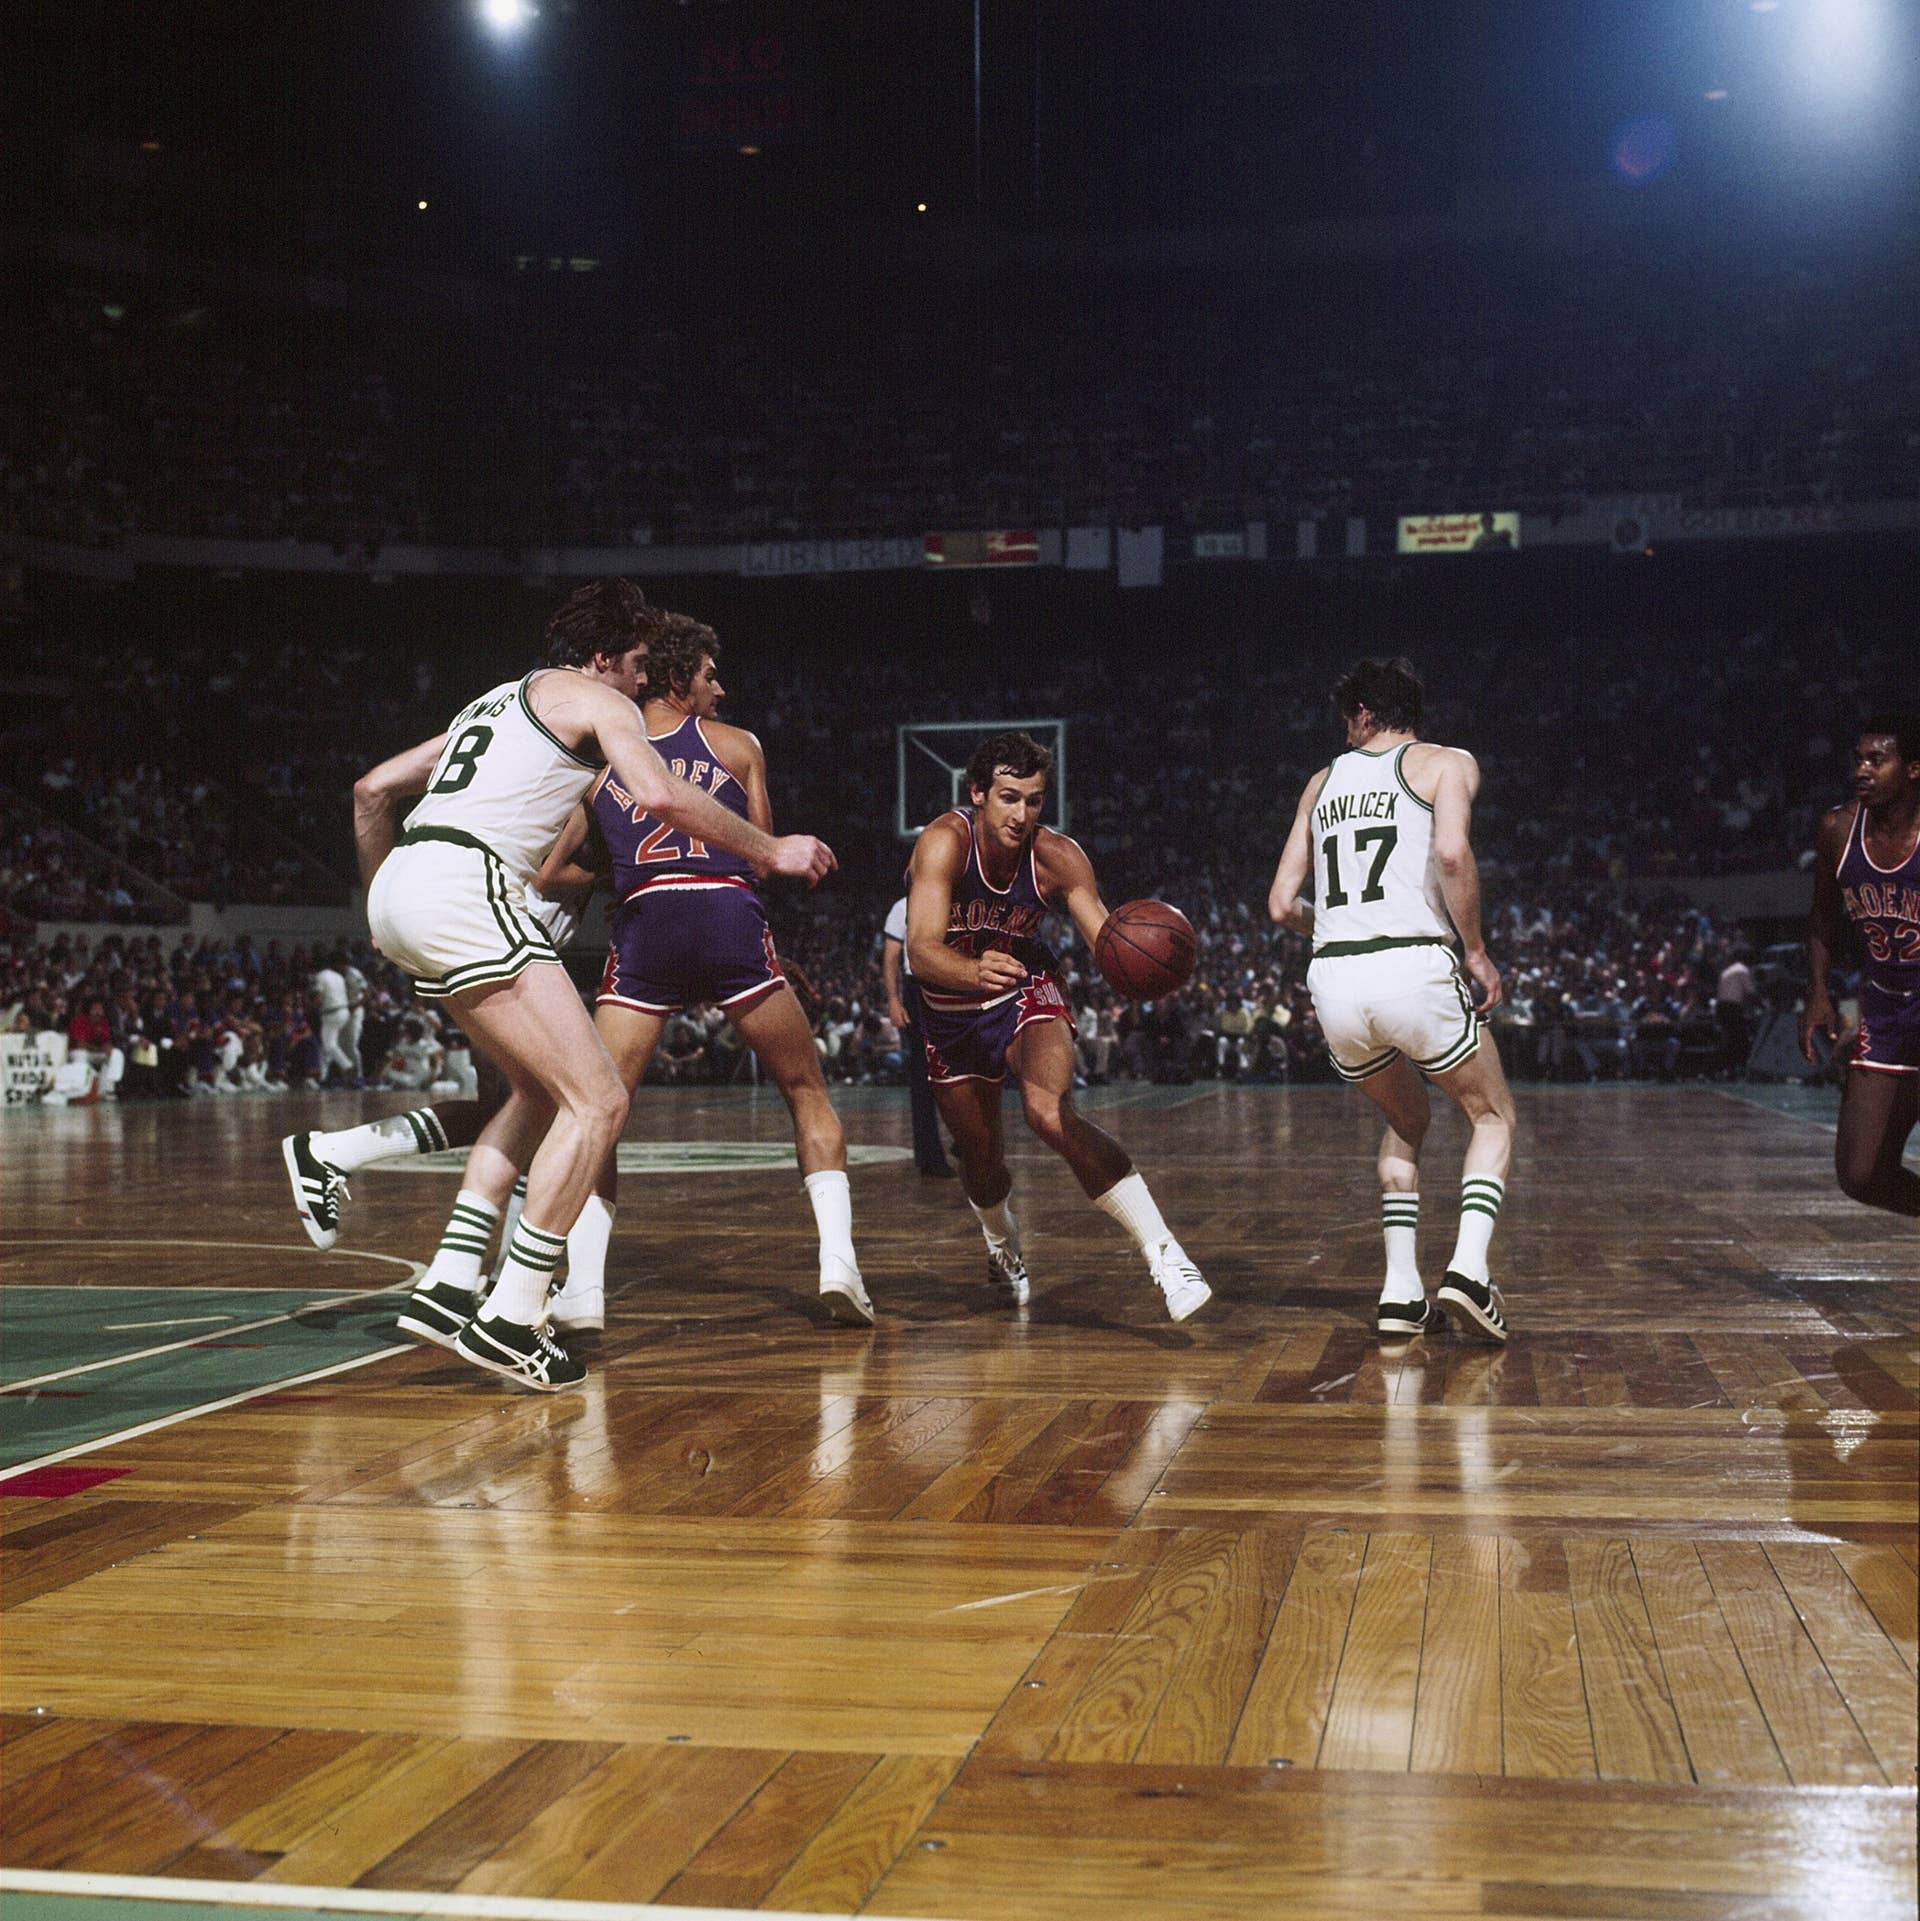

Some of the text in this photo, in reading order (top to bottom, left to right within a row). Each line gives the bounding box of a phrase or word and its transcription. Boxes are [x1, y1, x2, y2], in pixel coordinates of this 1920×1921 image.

[1317, 791, 1400, 833] HAVLICEK
[1322, 825, 1398, 909] 17
[1861, 920, 1920, 962] 32
[1033, 982, 1064, 1006] SU
